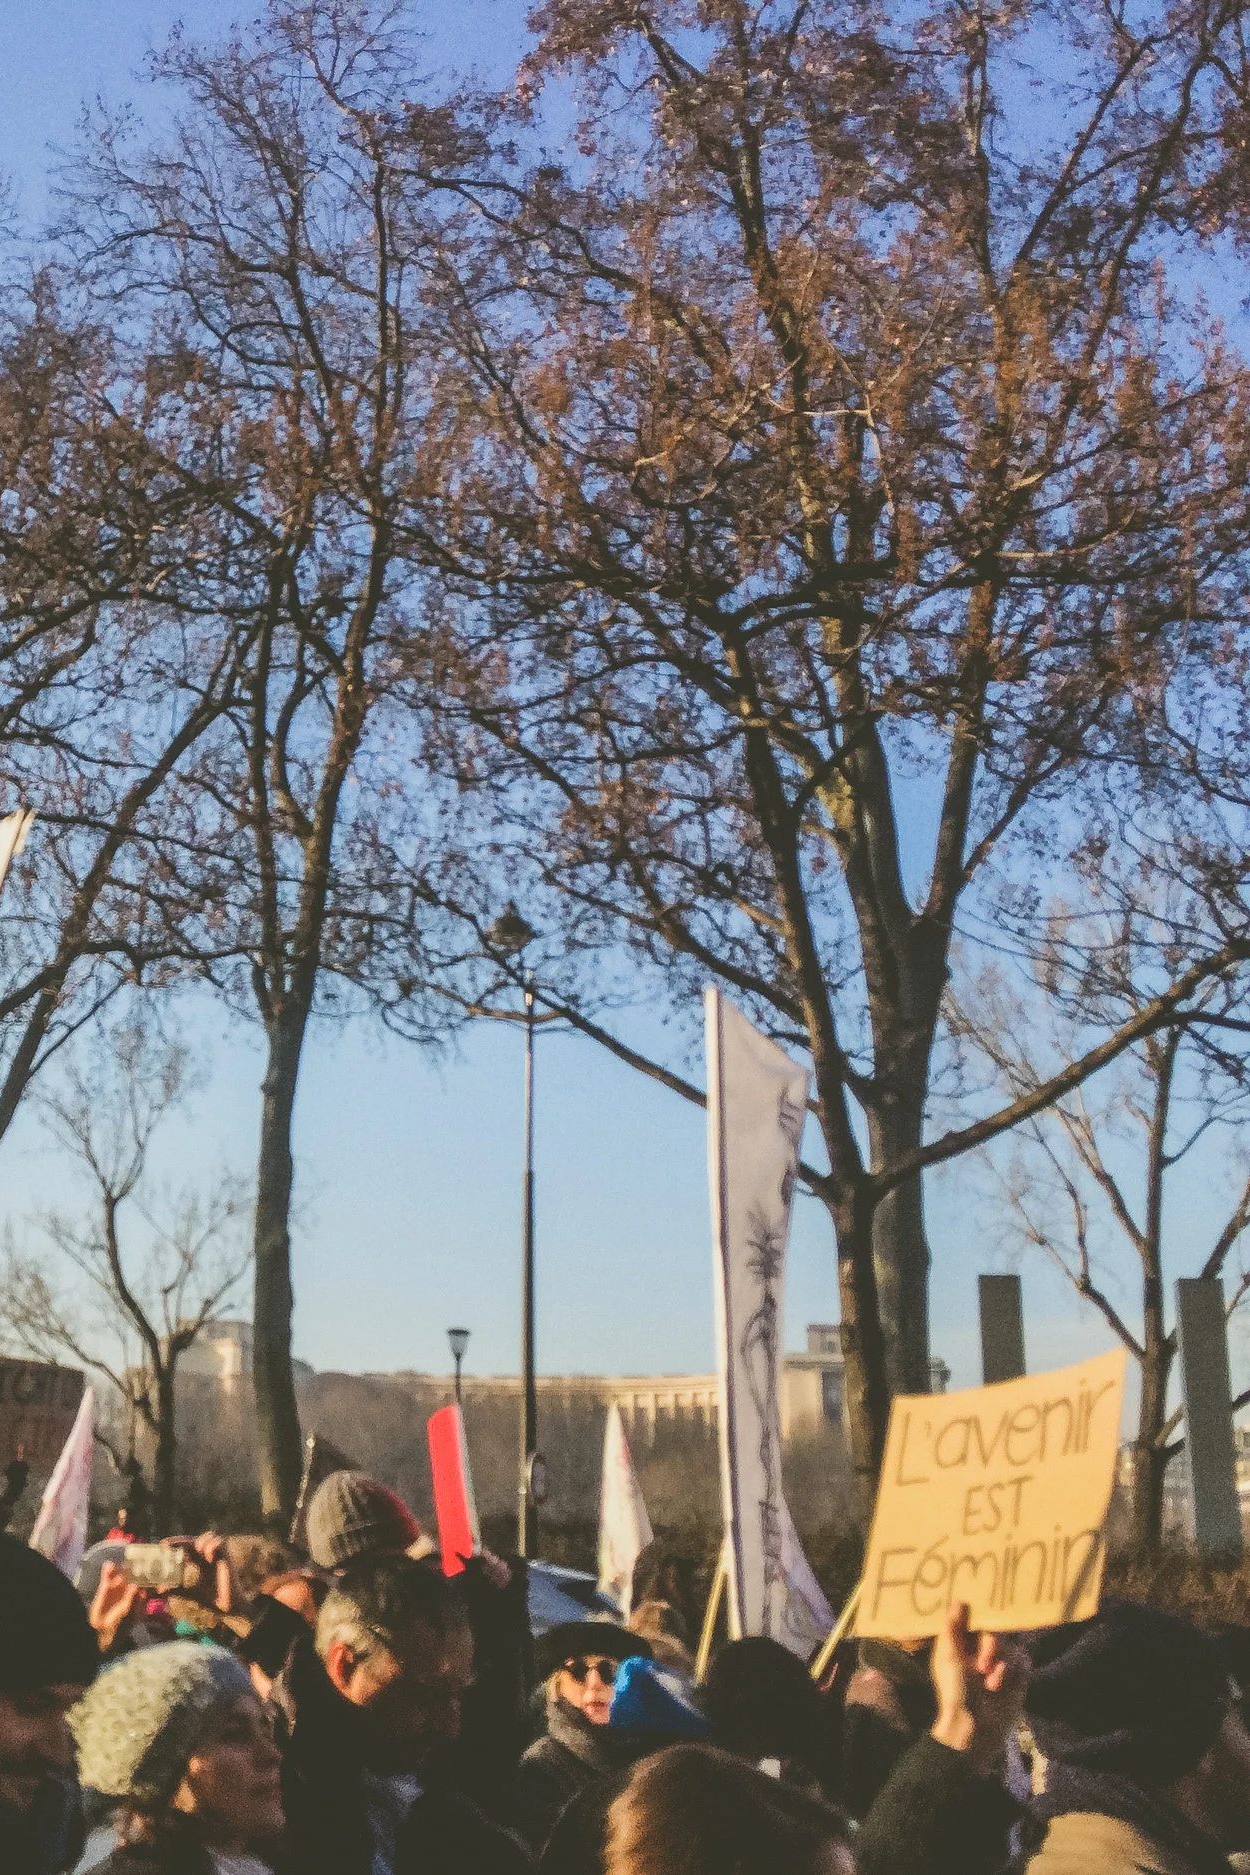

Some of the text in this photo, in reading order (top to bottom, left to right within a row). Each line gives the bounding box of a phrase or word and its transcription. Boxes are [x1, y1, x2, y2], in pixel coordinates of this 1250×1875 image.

[895, 1377, 1117, 1487] L'avenir
[962, 1475, 1035, 1537] EST
[871, 1524, 1106, 1622] Féminin
